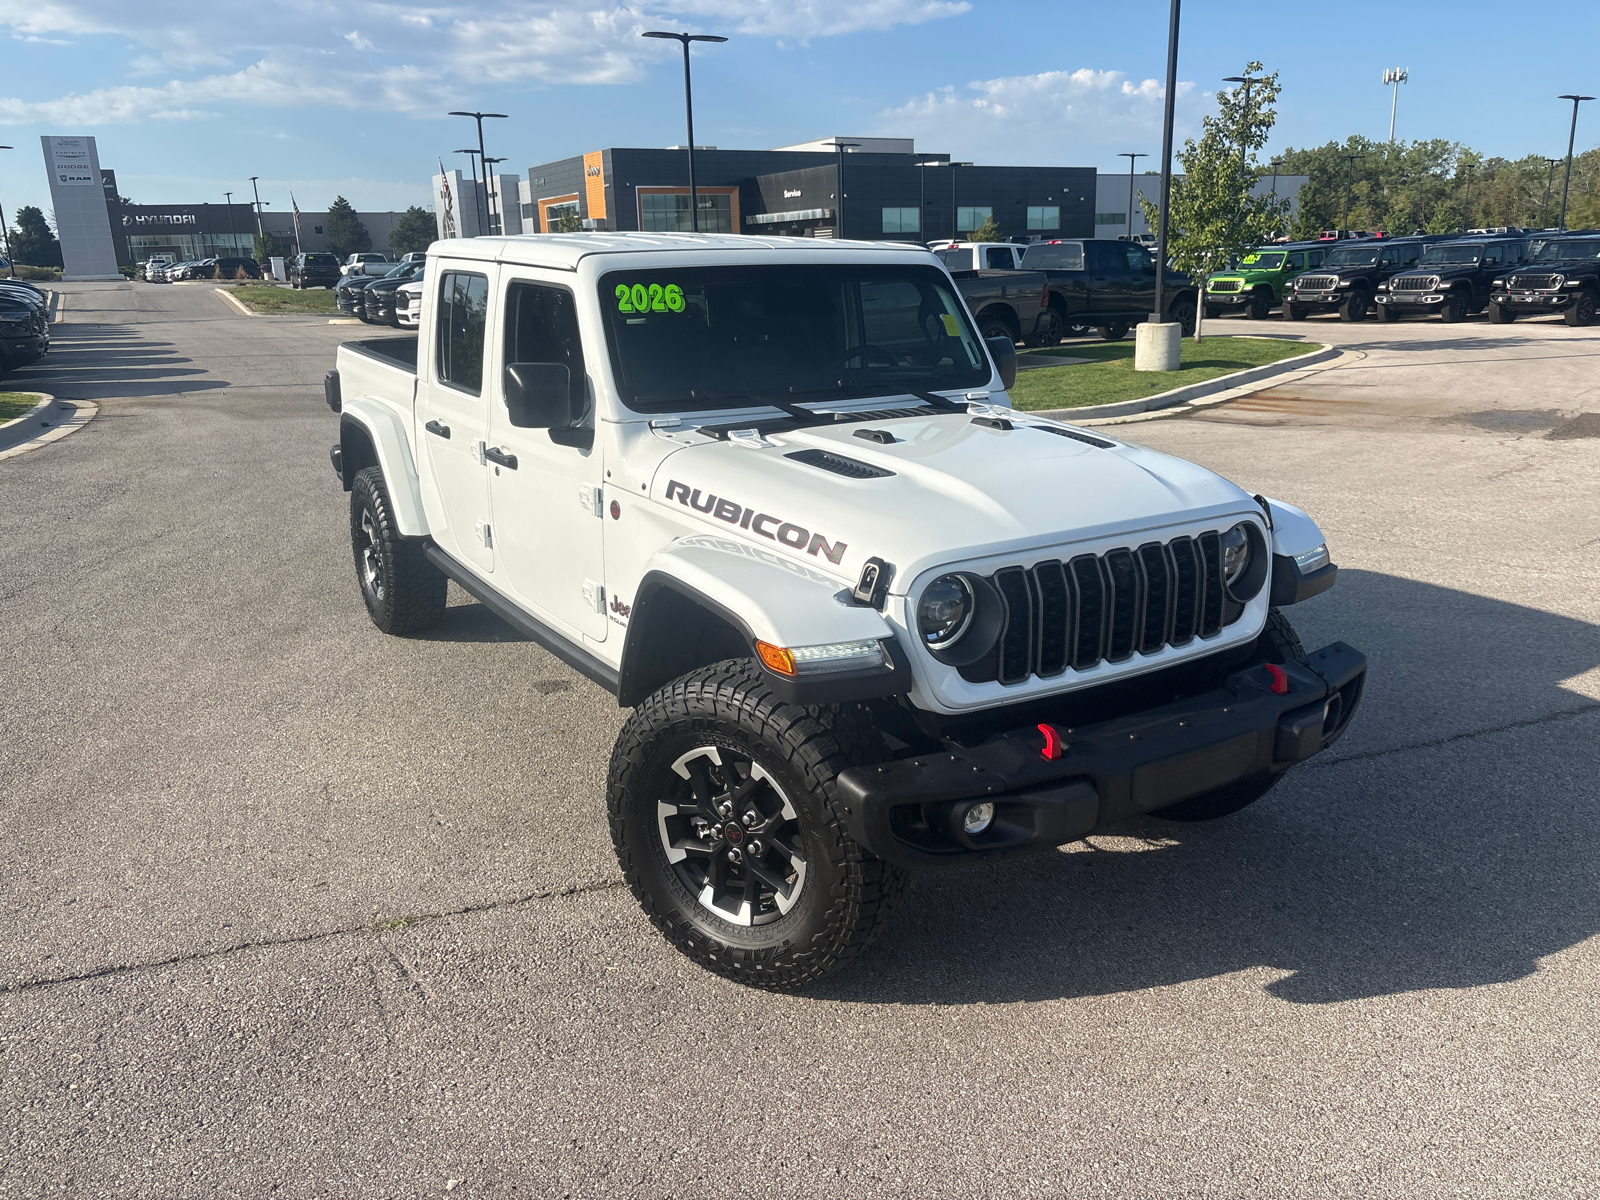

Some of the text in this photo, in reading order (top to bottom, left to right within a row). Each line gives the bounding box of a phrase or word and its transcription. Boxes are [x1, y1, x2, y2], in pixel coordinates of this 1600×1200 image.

[783, 189, 802, 198] Service
[135, 214, 196, 225] HYUNDAI
[615, 283, 686, 314] 2026
[665, 479, 848, 565] RUBICON
[610, 594, 631, 619] Jee
